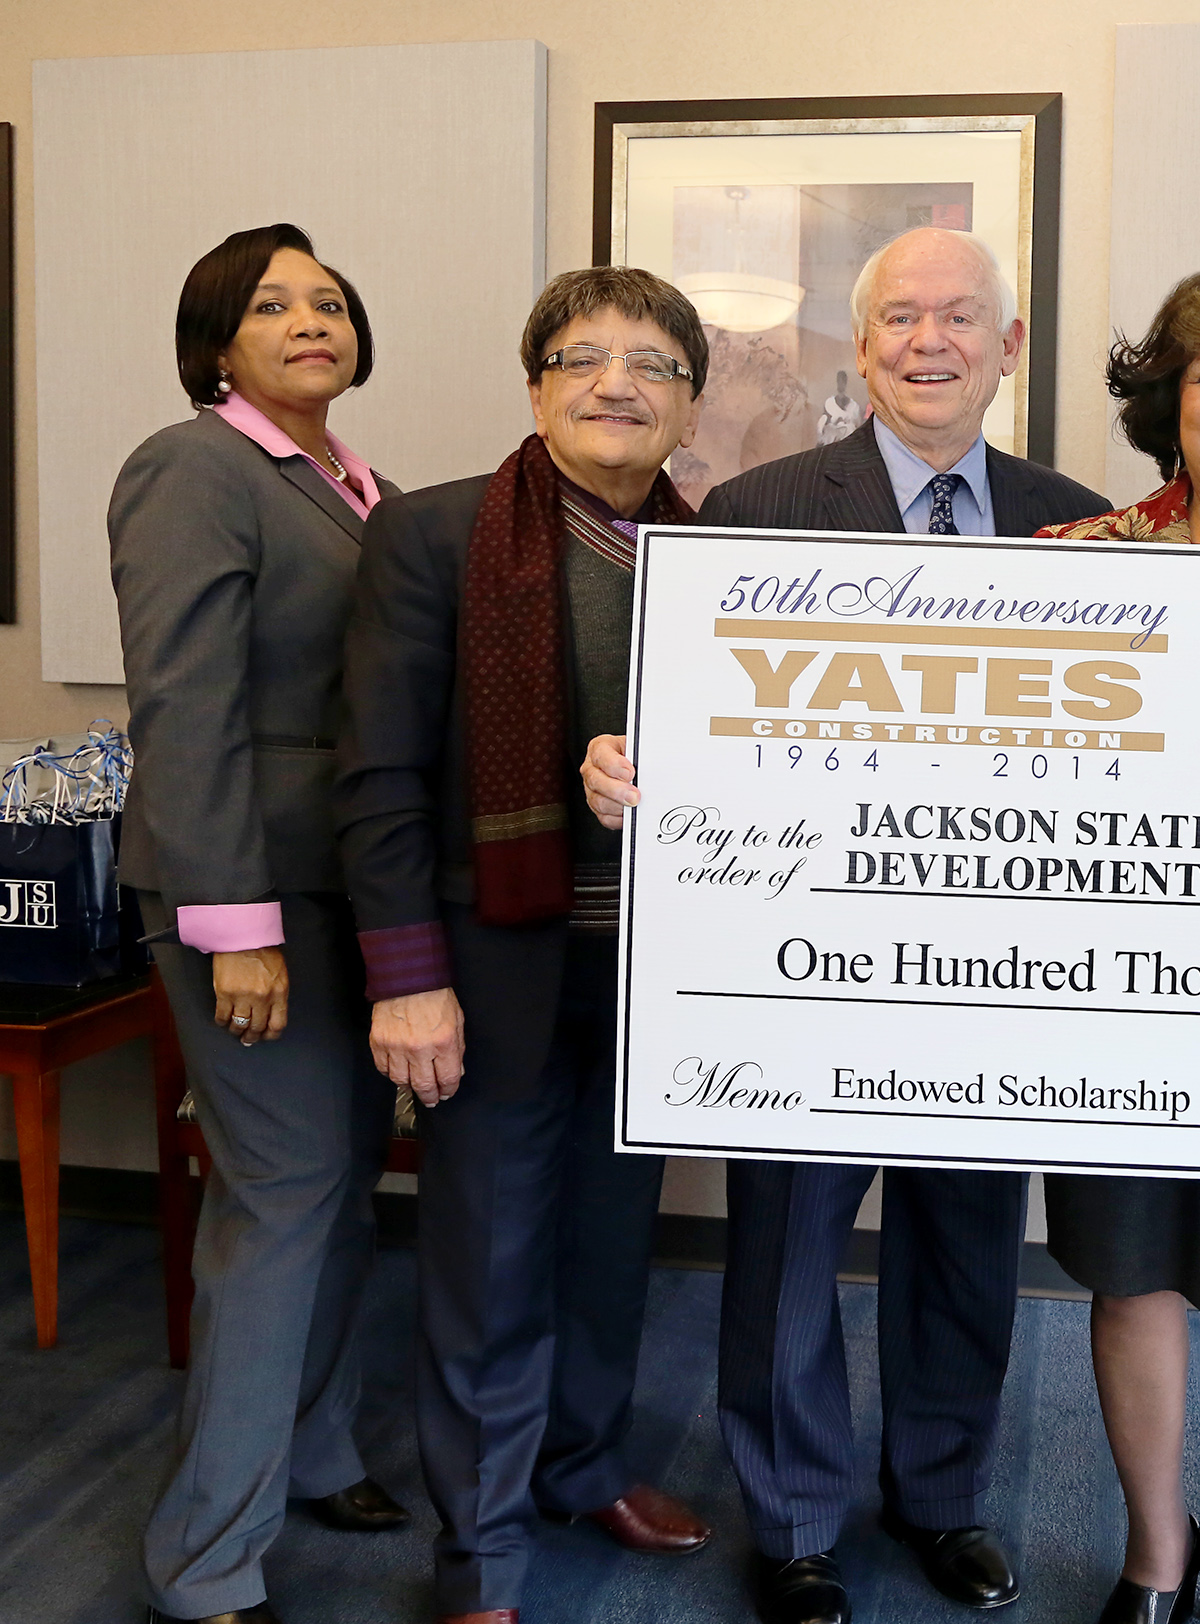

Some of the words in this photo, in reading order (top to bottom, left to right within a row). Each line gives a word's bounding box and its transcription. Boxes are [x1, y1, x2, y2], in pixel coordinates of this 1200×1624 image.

[721, 568, 823, 613] 50th
[827, 564, 1168, 649] Anniversary
[729, 648, 1143, 721] YATES
[752, 719, 1122, 748] CONSTRUCTION
[754, 744, 879, 772] 1964
[993, 753, 1121, 781] 2014
[656, 805, 737, 863] Pay
[742, 823, 773, 849] to
[778, 819, 823, 850] the
[850, 803, 1060, 845] JACKSON
[677, 855, 761, 887] order
[764, 856, 808, 900] of
[776, 937, 874, 983] One
[891, 942, 1097, 993] Hundred
[664, 1056, 807, 1112] Memo
[831, 1067, 985, 1106] Endowed
[998, 1075, 1191, 1121] Scholarship
